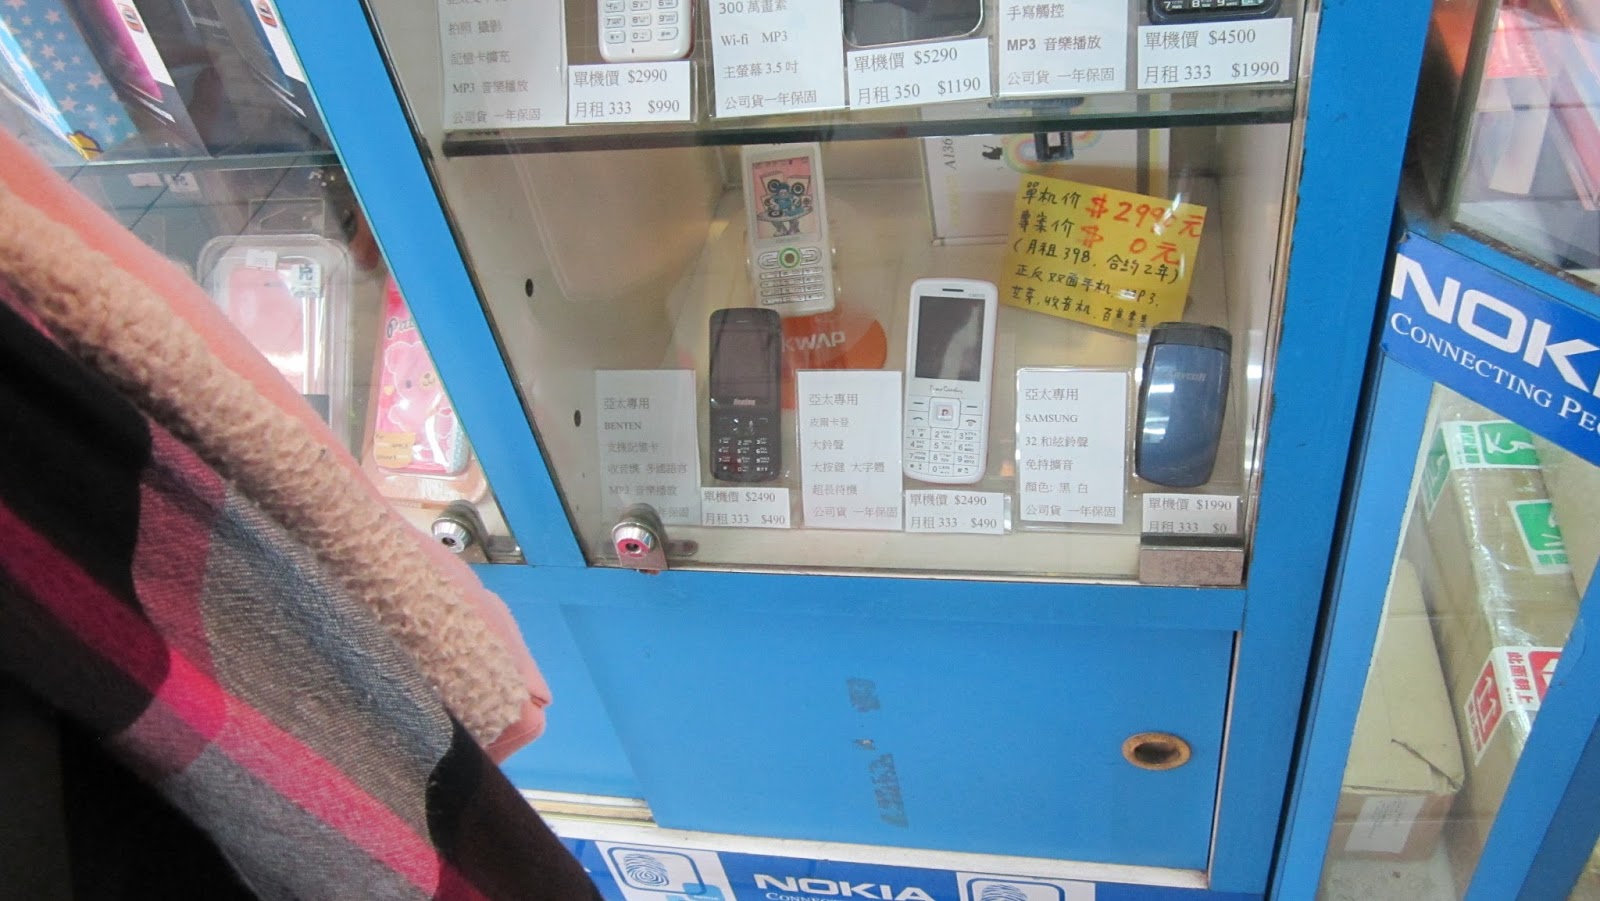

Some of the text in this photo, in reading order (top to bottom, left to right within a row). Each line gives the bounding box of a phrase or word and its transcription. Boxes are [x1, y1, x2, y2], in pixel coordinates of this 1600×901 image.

[719, 2, 743, 14] 300
[721, 31, 788, 46] Wi-fi MP3
[1007, 35, 1101, 51] MP3 音樂播放
[1144, 29, 1255, 49] 單機價 $4500
[854, 48, 957, 72] 單機價 $5290
[766, 63, 782, 74] 3.5
[1144, 62, 1279, 84] 月租 333 $1990
[574, 69, 667, 87] 單機價 $2990
[1008, 67, 1115, 85] 公司貨 一年保固
[453, 83, 475, 94] MP3
[857, 78, 980, 105] 月租 350 $1190
[575, 100, 680, 118] 月租 333 $990
[809, 394, 858, 406] 亞太專用
[1025, 388, 1079, 401] 亞太專用
[604, 398, 650, 410] 亞太專用
[1025, 414, 1078, 423] SAMSUNG
[605, 422, 642, 431] BENTEN
[1025, 436, 1037, 446] 32
[1026, 459, 1073, 471] 免持擴音
[1059, 483, 1070, 493] 黑
[1078, 483, 1088, 494] 白
[704, 491, 775, 502] 單機價 $2490
[910, 494, 987, 506] 單機價 $2490
[1150, 498, 1231, 511] 單機價 $1990
[1026, 505, 1116, 517] 公司貨 一年保固
[705, 513, 785, 524] 月租 333 $490
[910, 517, 997, 529] 月租 333 $490
[1150, 521, 1227, 534] 月租 333 $0
[754, 873, 936, 901] NOKIA
